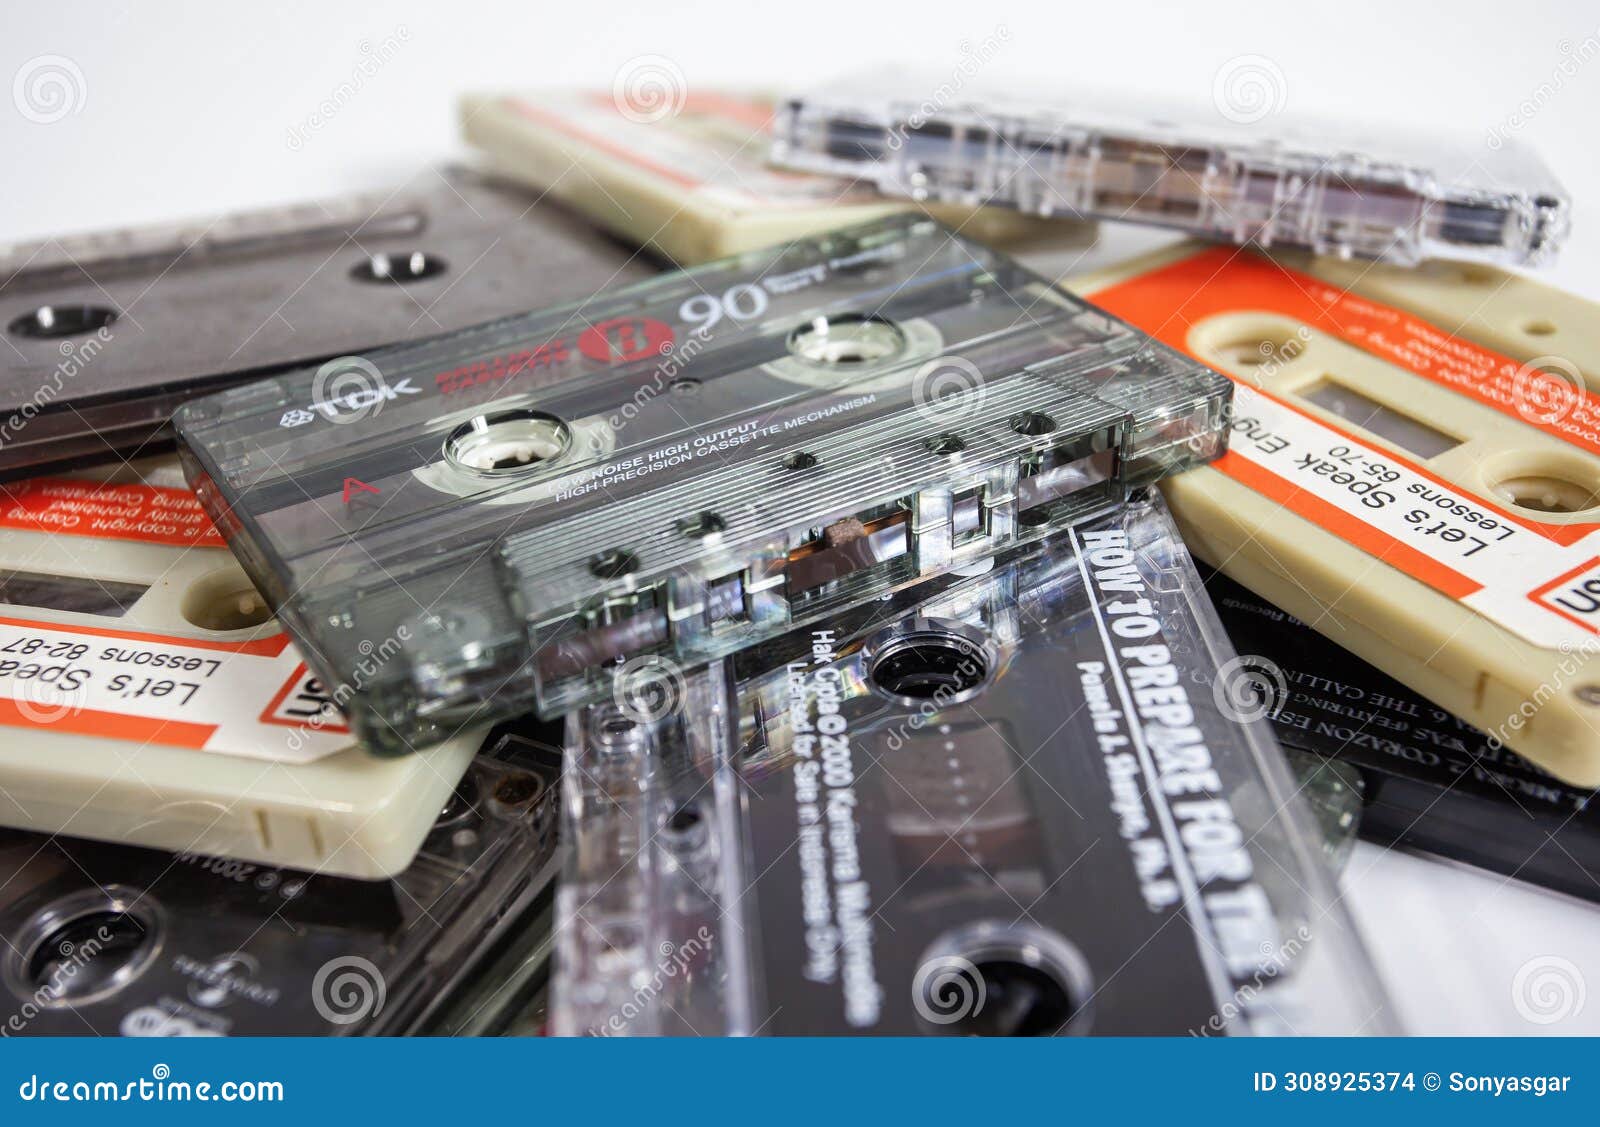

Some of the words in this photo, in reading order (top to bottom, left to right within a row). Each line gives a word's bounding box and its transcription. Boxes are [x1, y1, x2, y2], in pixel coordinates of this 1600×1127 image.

[679, 283, 769, 336] 90
[308, 378, 423, 416] TDK
[555, 481, 598, 502] HIGH
[602, 452, 693, 488] PRECISION
[696, 425, 780, 457] CASSETTE
[783, 394, 876, 429] MECHANISM
[591, 457, 644, 480] NOISE
[648, 442, 690, 462] HIGH
[694, 419, 761, 447] OUTPUT
[1328, 446, 1401, 484] 65-70
[41, 485, 144, 506] Corporation
[343, 477, 381, 504] A
[1294, 452, 1396, 510] Speak
[7, 507, 80, 528] Copying
[145, 508, 204, 523] strictly
[183, 526, 199, 537] is
[1406, 482, 1516, 542] Lessons
[1404, 508, 1489, 559] Let's
[1081, 529, 1146, 592] HOW
[1105, 597, 1162, 639] TO
[2, 637, 90, 661] 82-87
[99, 646, 223, 678] Lessons
[811, 629, 837, 665] Hak
[108, 673, 201, 707] Let's
[786, 661, 816, 734] Licensed
[1076, 660, 1124, 733] Pamela
[1370, 691, 1422, 719] THE
[1119, 643, 1224, 797] PREPARE
[791, 732, 818, 760] for
[1318, 719, 1442, 770] CORAZON
[792, 759, 821, 803] Sale
[1171, 797, 1254, 884] FOR
